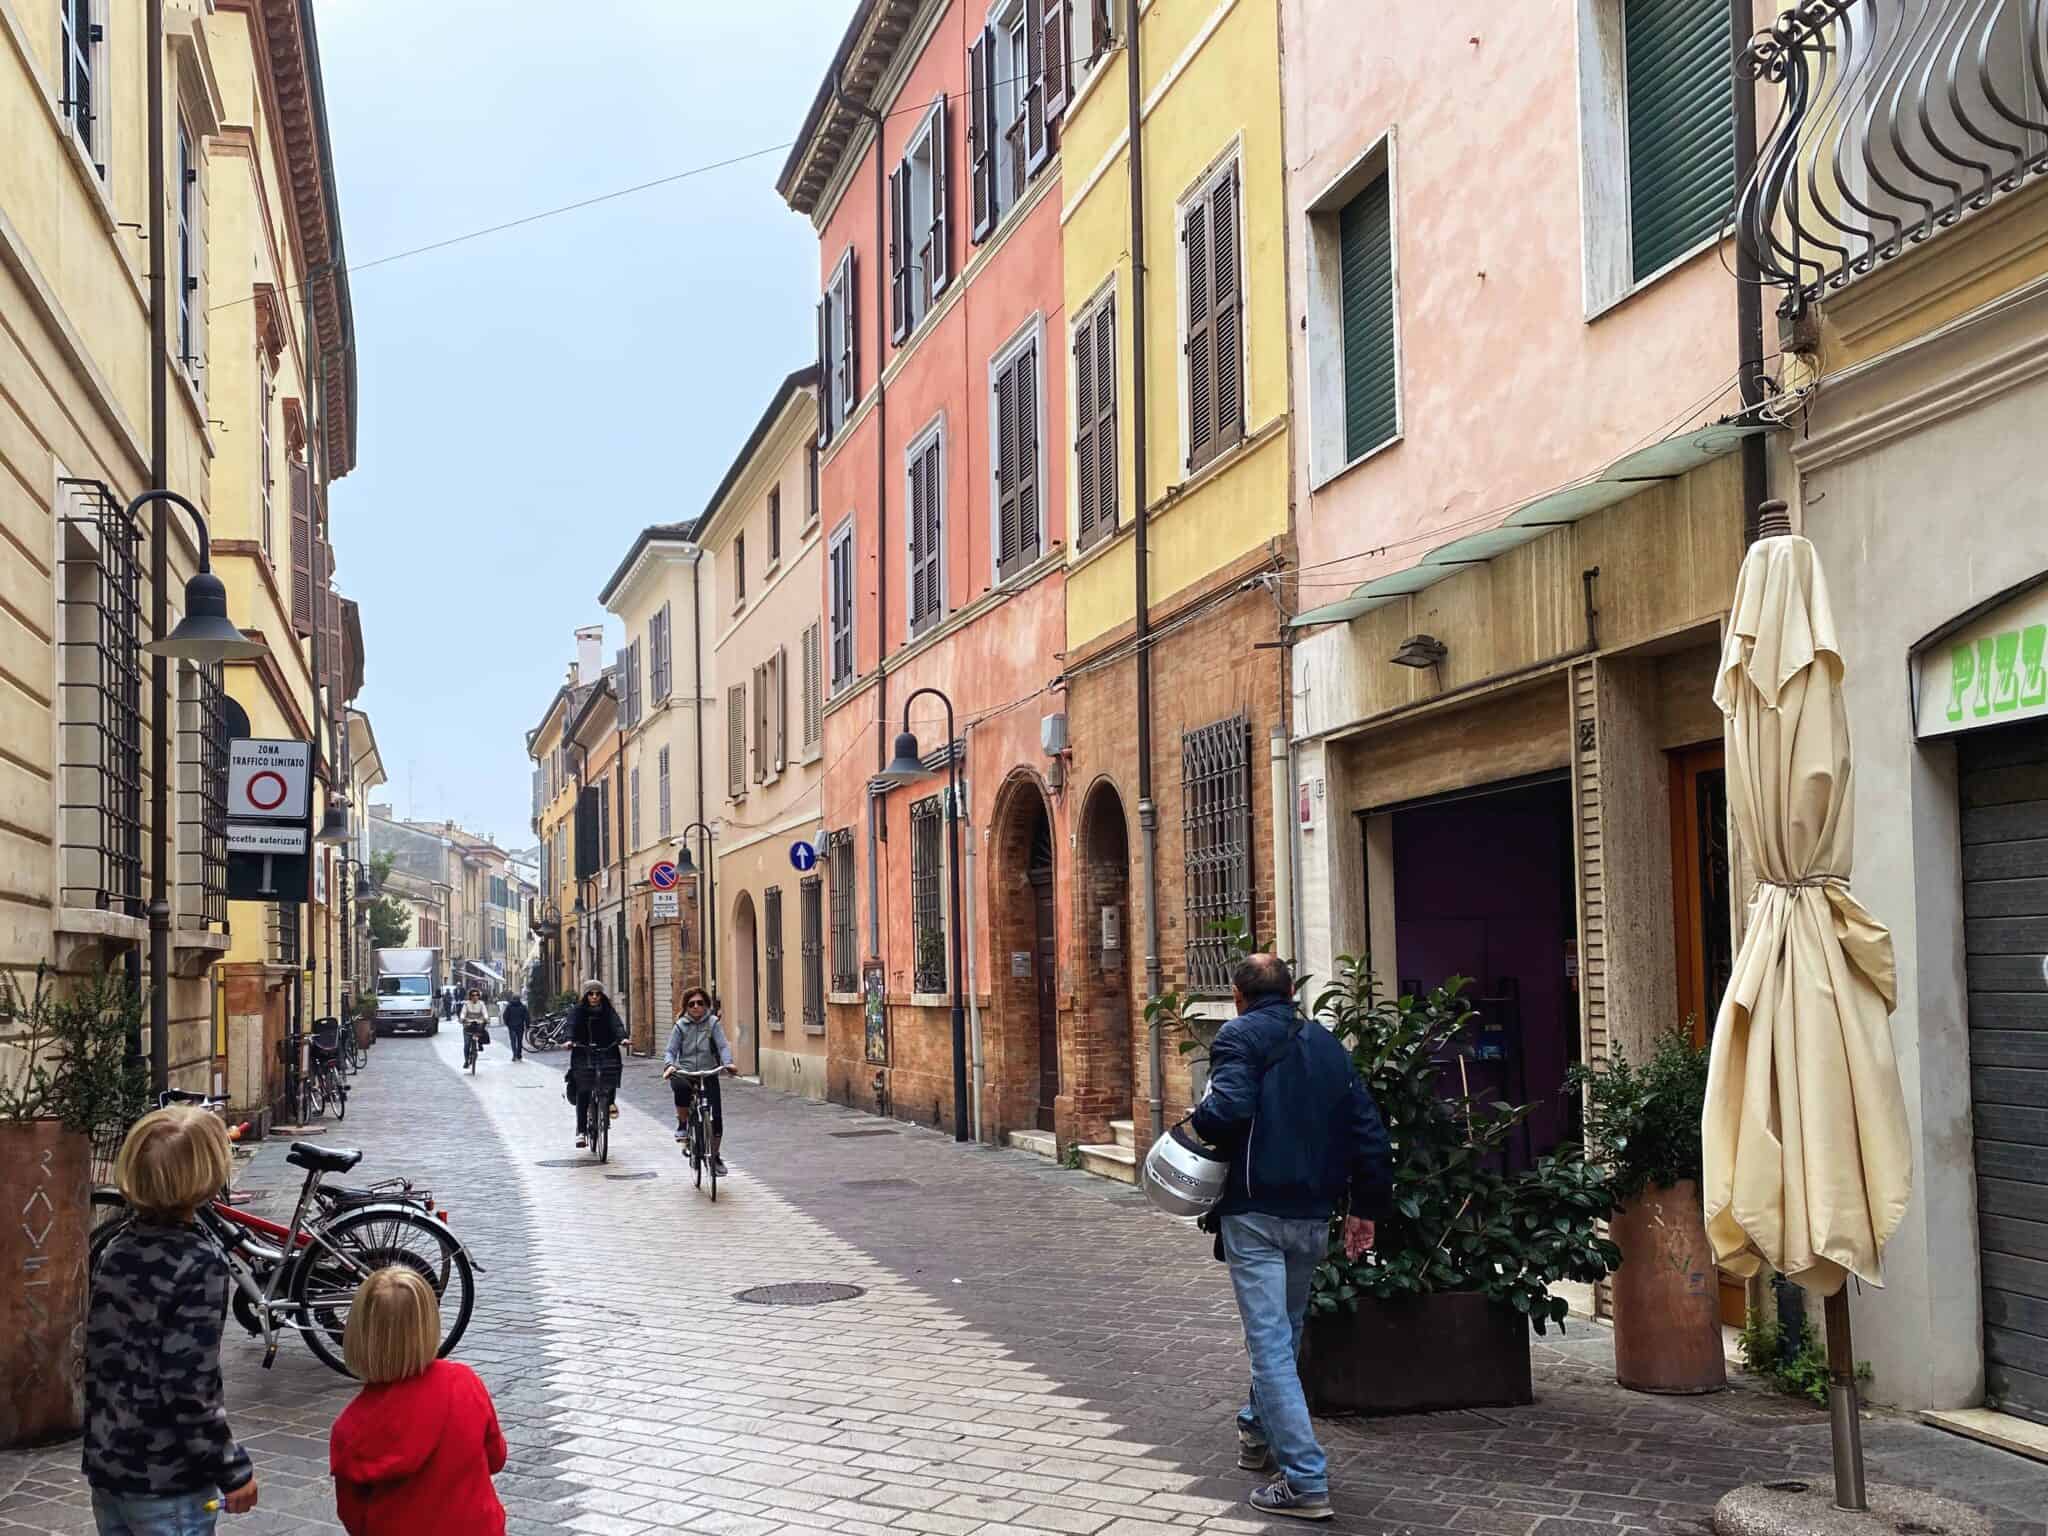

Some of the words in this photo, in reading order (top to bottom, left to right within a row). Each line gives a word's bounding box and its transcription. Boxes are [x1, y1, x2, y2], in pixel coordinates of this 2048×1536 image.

[1946, 624, 2047, 722] PIZZ
[258, 745, 279, 755] ZONA
[232, 756, 269, 766] TRAFFICO
[271, 757, 305, 767] LIMITATO
[260, 836, 302, 846] autorizzati
